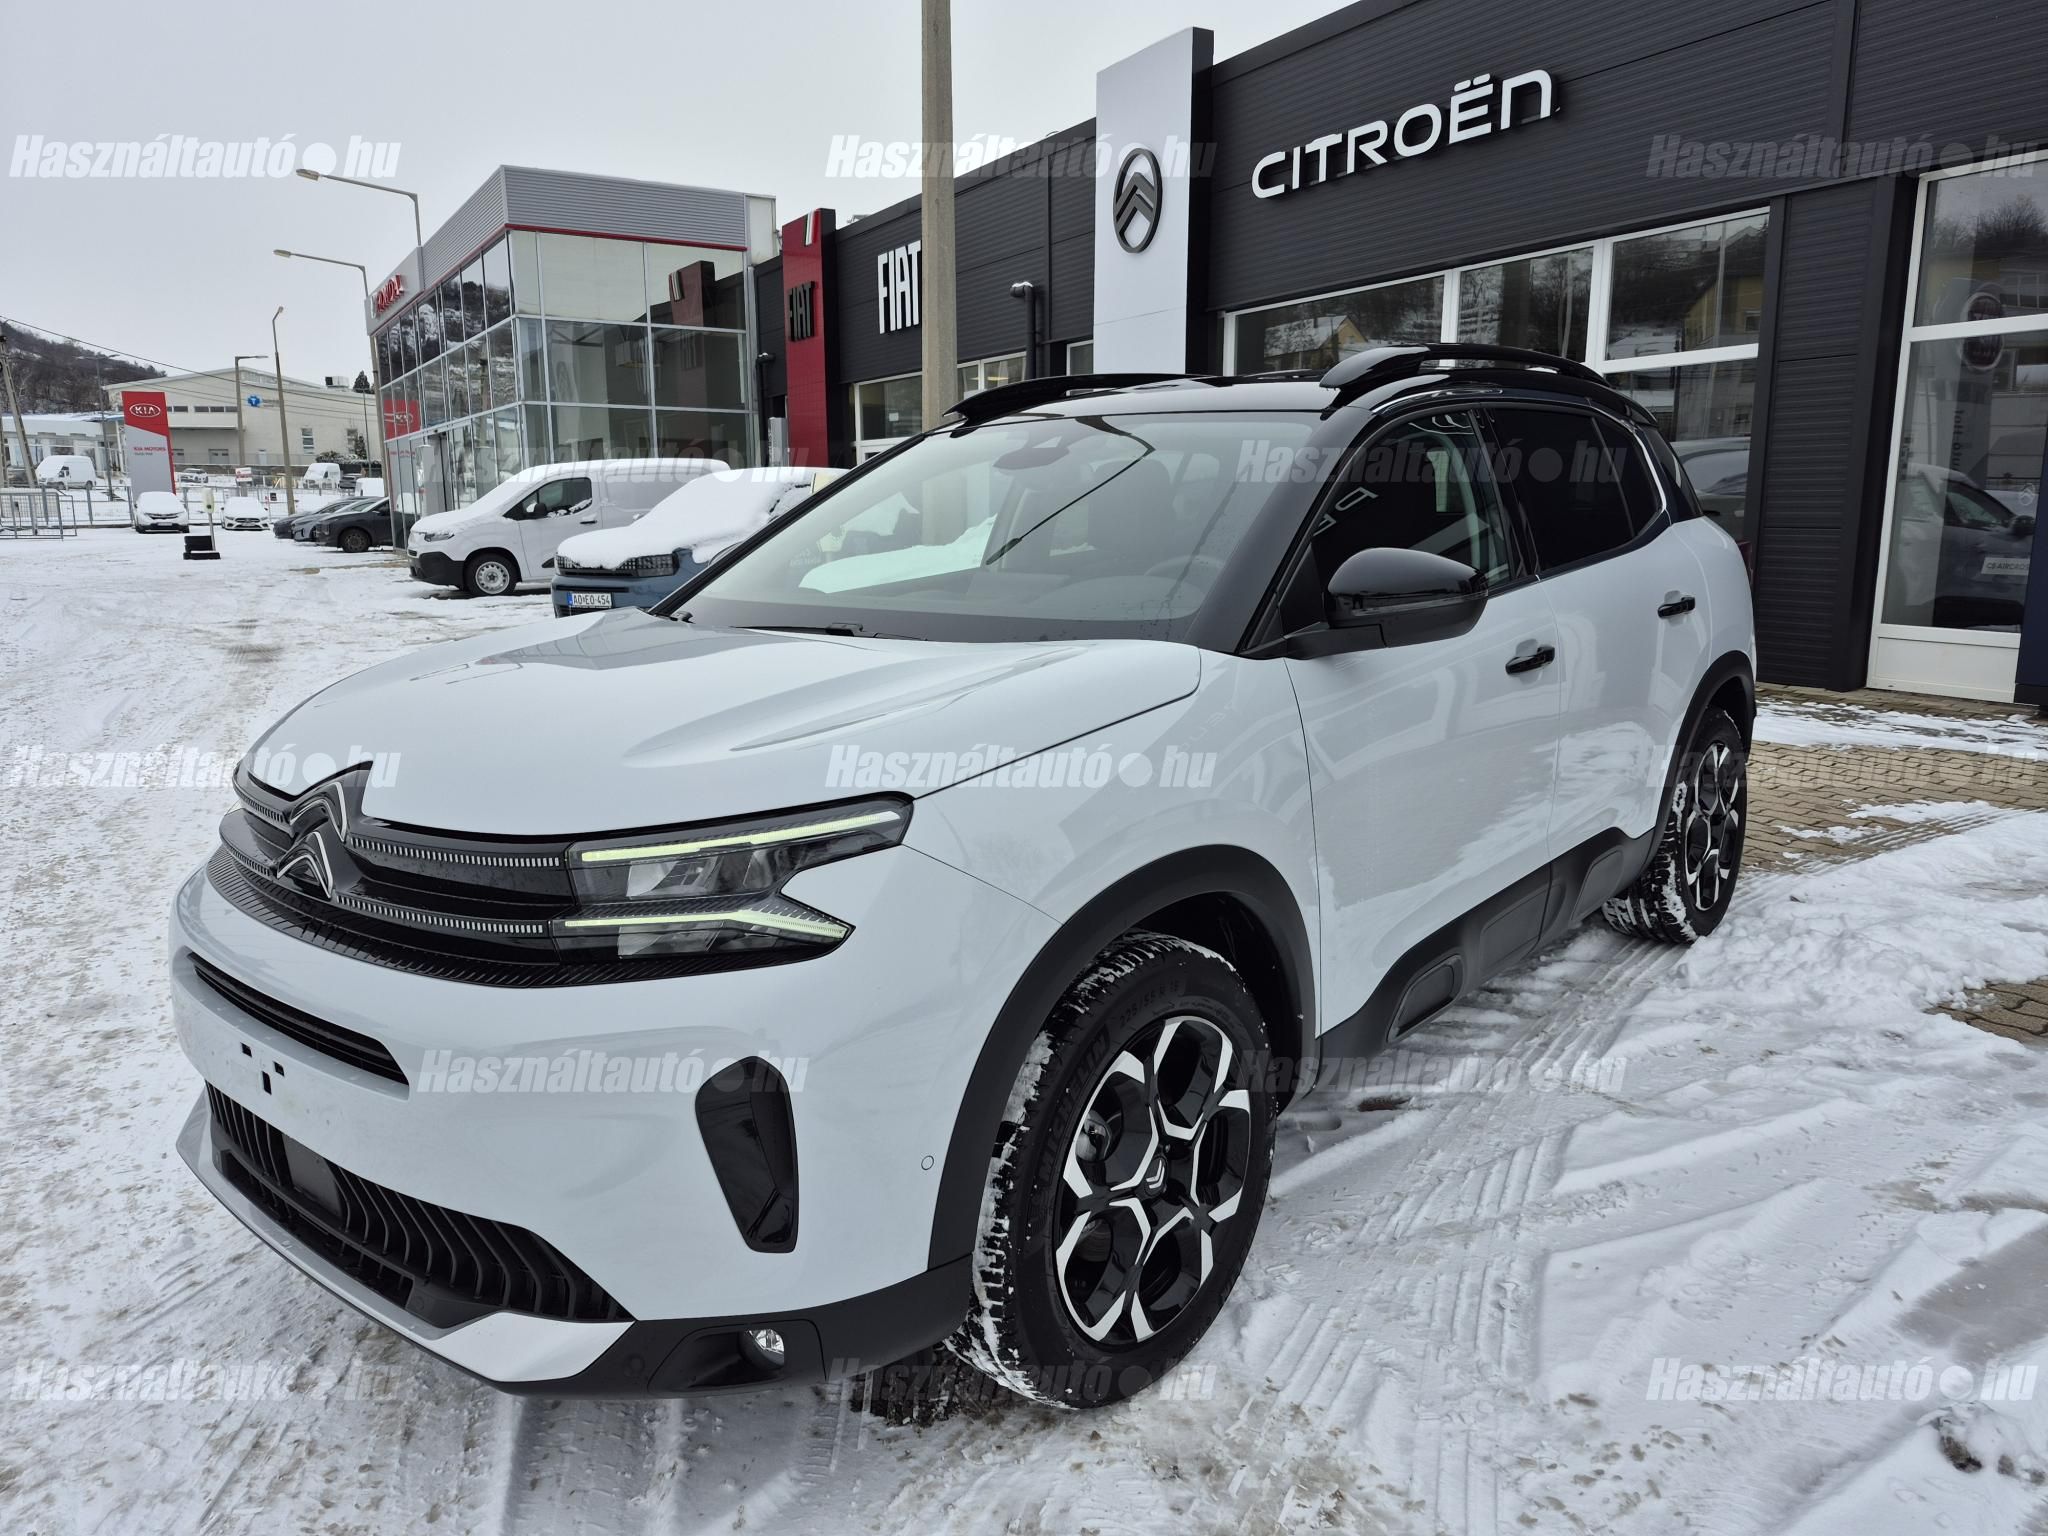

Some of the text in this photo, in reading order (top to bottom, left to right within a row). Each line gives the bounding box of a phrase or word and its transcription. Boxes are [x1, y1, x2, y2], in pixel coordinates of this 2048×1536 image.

[1252, 69, 1553, 199] CITROËN
[788, 281, 815, 342] FIAT
[878, 240, 922, 335] FIAT
